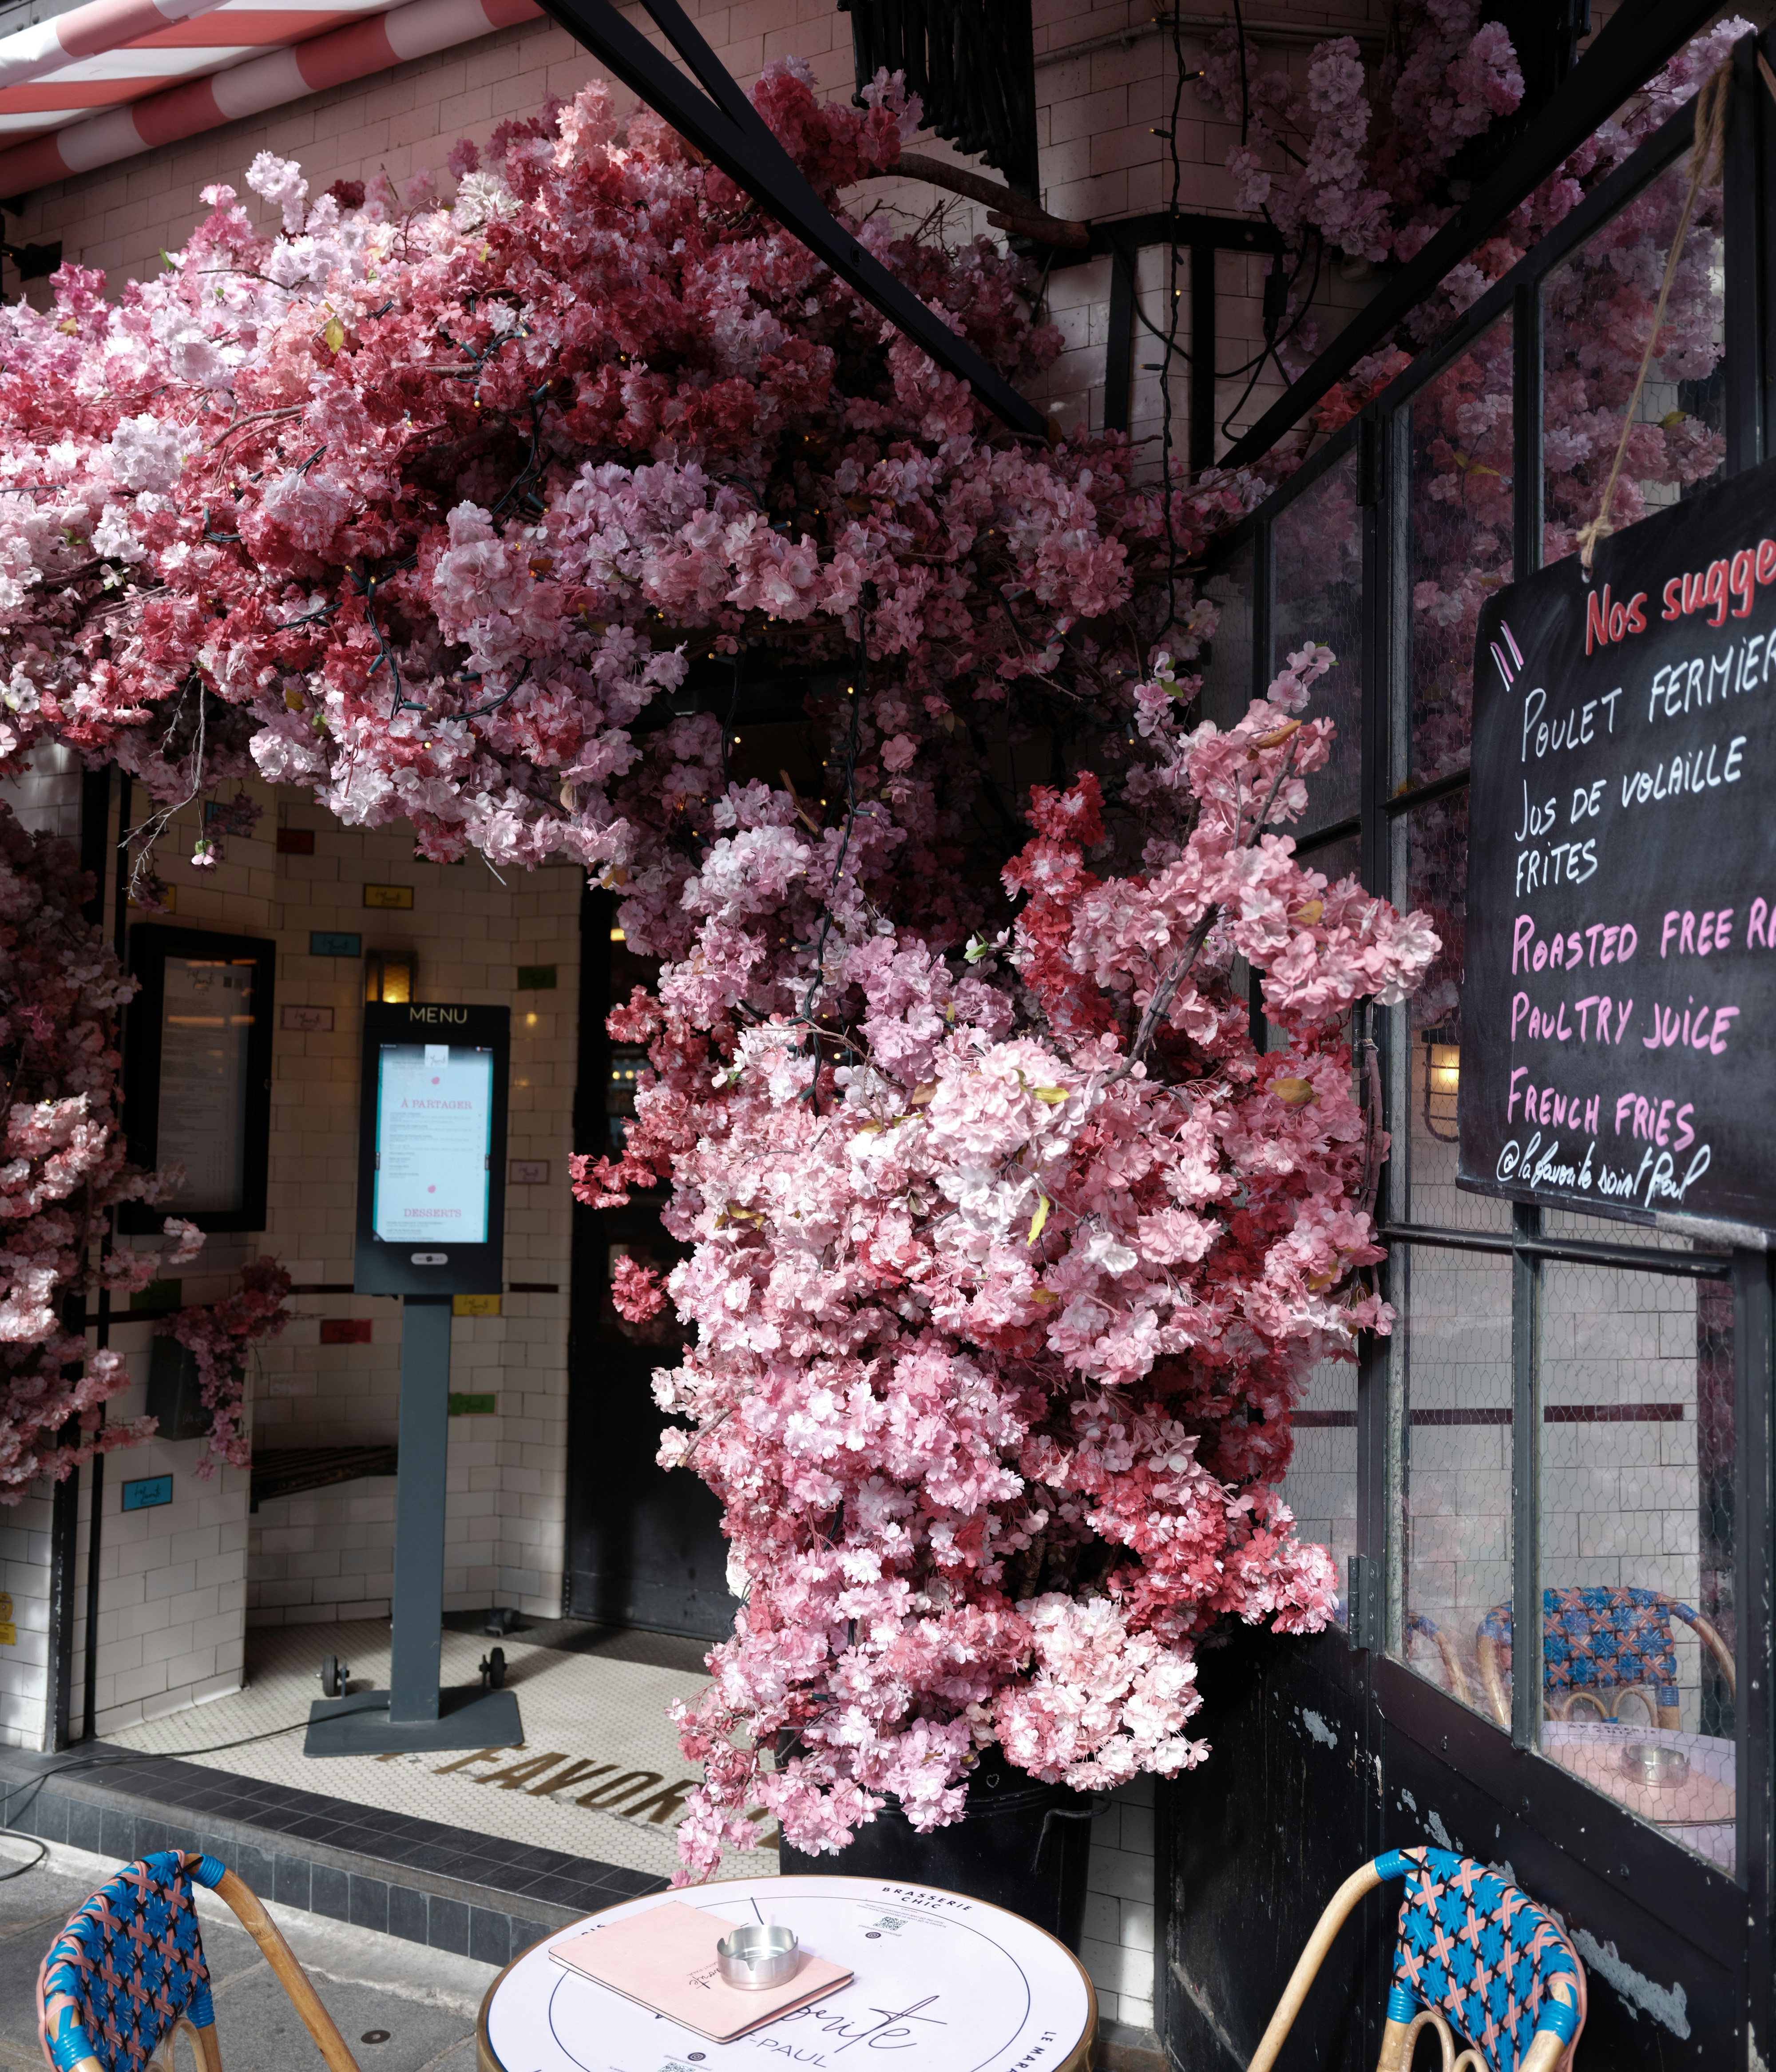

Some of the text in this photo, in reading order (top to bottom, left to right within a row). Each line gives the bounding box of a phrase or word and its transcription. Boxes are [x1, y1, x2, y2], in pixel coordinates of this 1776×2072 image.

[1586, 539, 1776, 655] Nos sugge
[1522, 688, 1622, 762] POULET
[1570, 780, 1607, 824] DE
[1512, 914, 1638, 975] ROASTED
[1660, 908, 1734, 959] FREE
[409, 1006, 468, 1024] MENU
[1511, 991, 1633, 1045] PAULTRY
[412, 1100, 472, 1109] PARTAGER
[1508, 1066, 1600, 1135] FRENCH
[404, 1208, 462, 1218] DESSERTS
[882, 1887, 972, 1911] BRASSERIE
[901, 1897, 941, 1909] CHIC
[1041, 2032, 1057, 2042] LE
